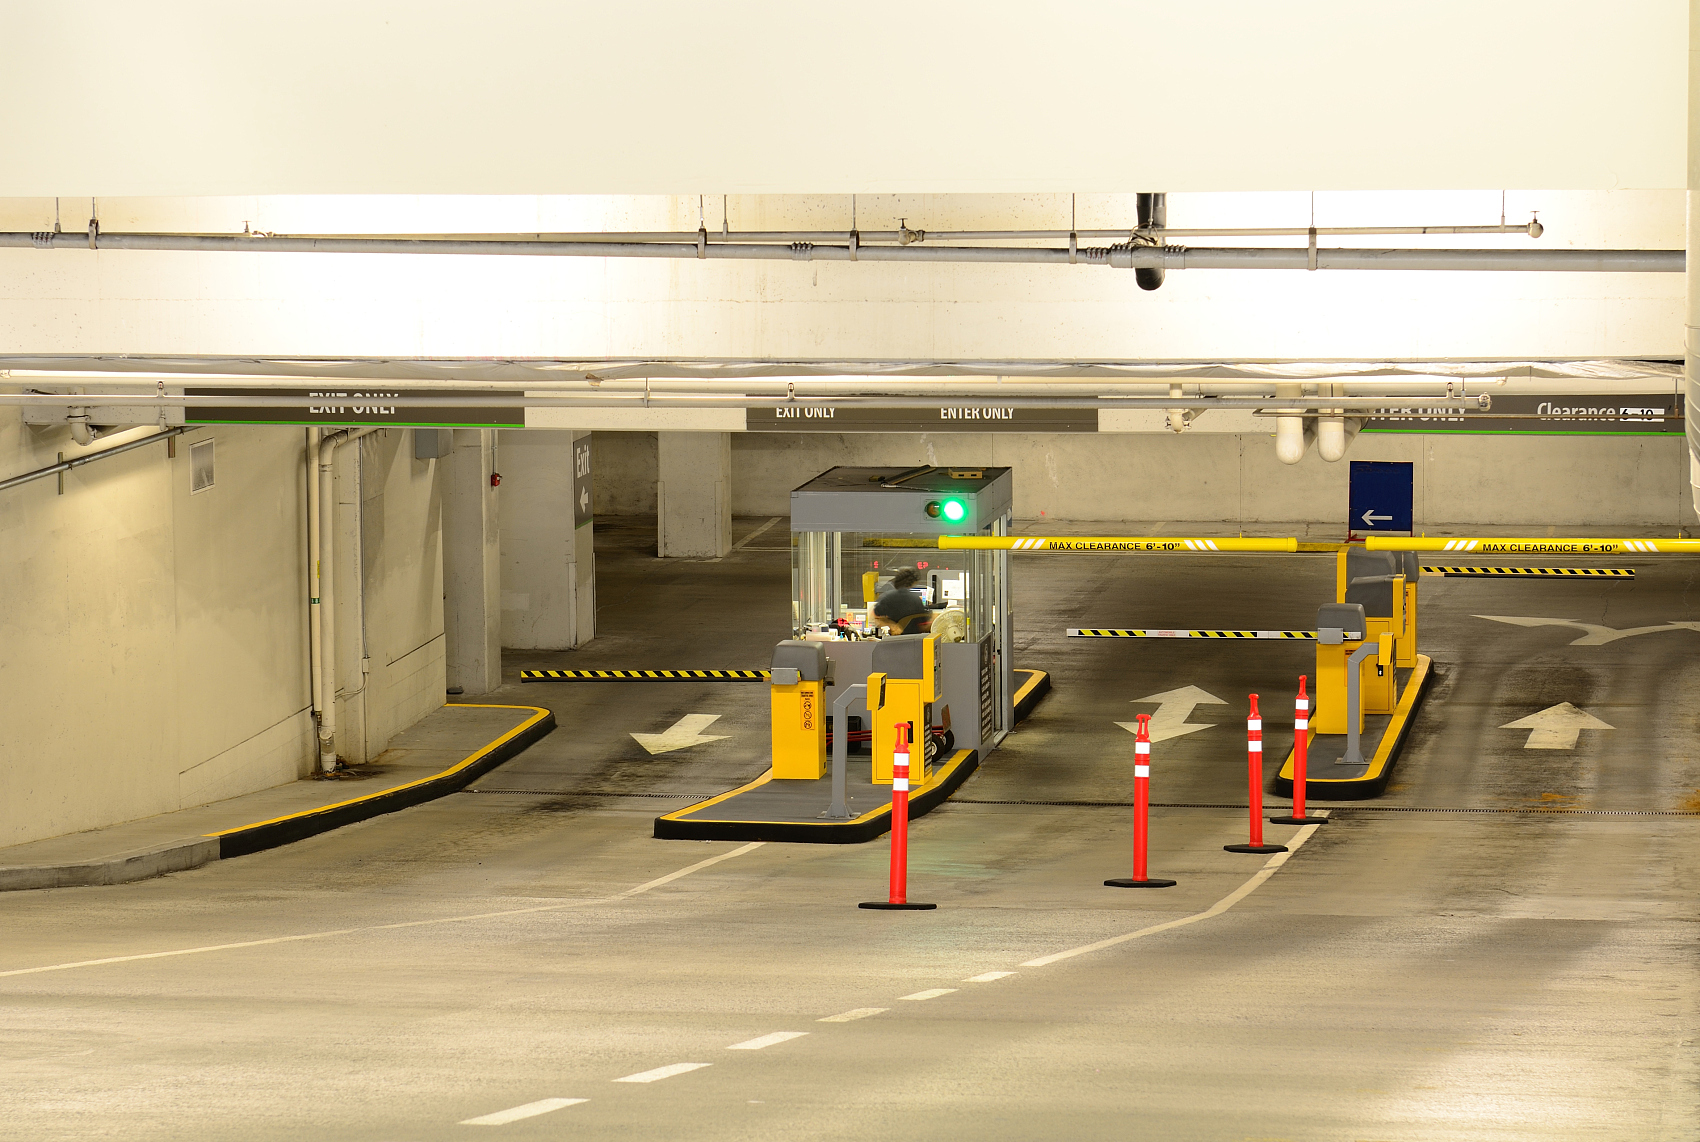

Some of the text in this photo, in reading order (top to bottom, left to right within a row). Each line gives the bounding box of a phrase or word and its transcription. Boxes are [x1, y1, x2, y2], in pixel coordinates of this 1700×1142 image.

[776, 407, 801, 418] EXIT
[940, 408, 1014, 420] ENTER ONLY
[1537, 402, 1616, 421] Clearance
[576, 444, 590, 479] Exit
[1049, 541, 1073, 551] MAX
[1075, 541, 1142, 551] CLEARANCE
[1482, 543, 1508, 552] MAX
[1509, 543, 1578, 552] CLEARANCE
